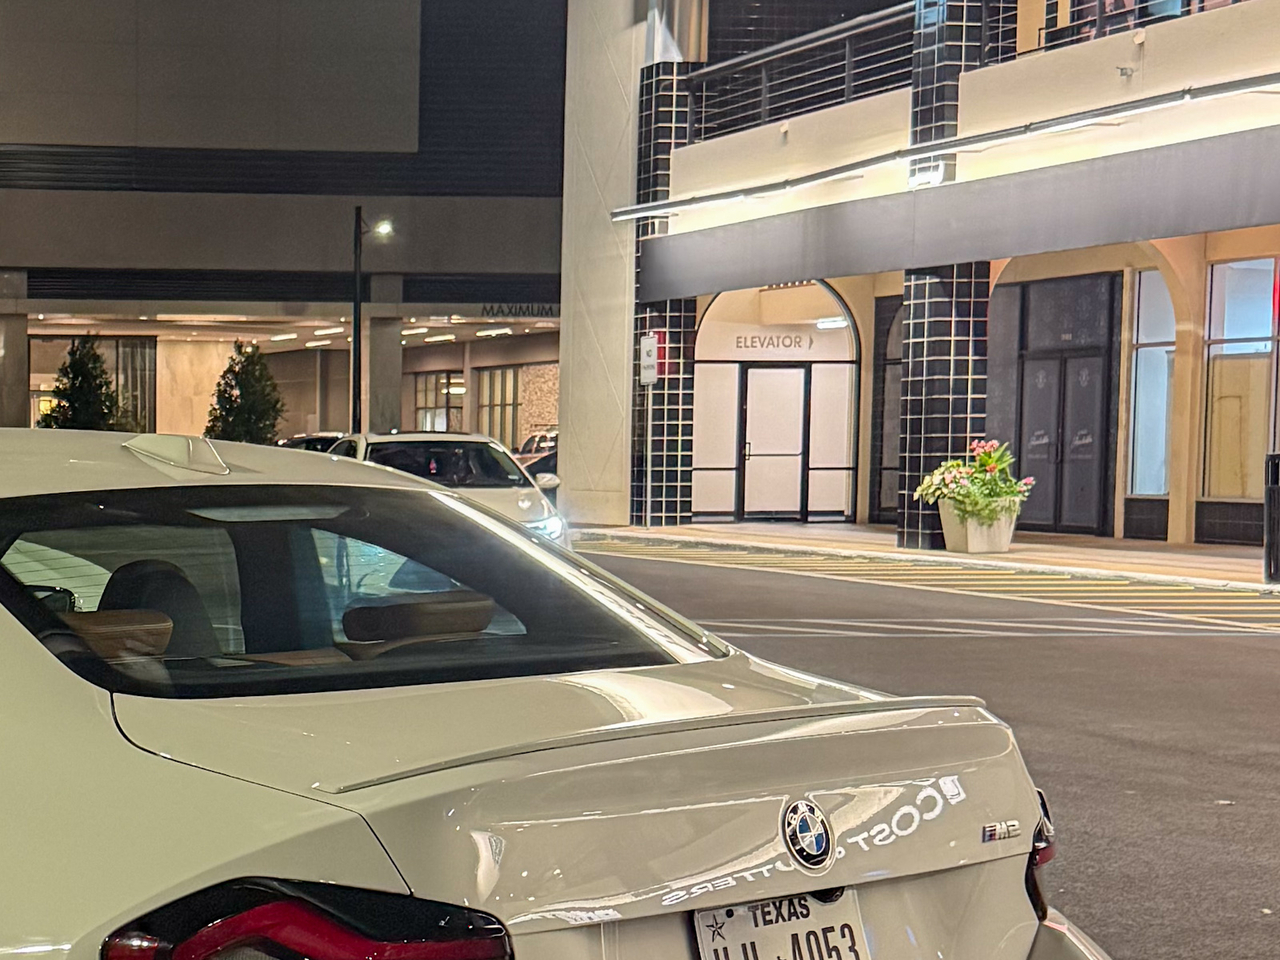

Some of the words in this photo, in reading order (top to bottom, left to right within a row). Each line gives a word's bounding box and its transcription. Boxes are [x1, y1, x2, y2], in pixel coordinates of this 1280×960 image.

[481, 303, 554, 317] MAXIMUM
[735, 335, 802, 349] ELEVATOR
[982, 820, 1021, 843] M2
[748, 897, 811, 928] TEXAS
